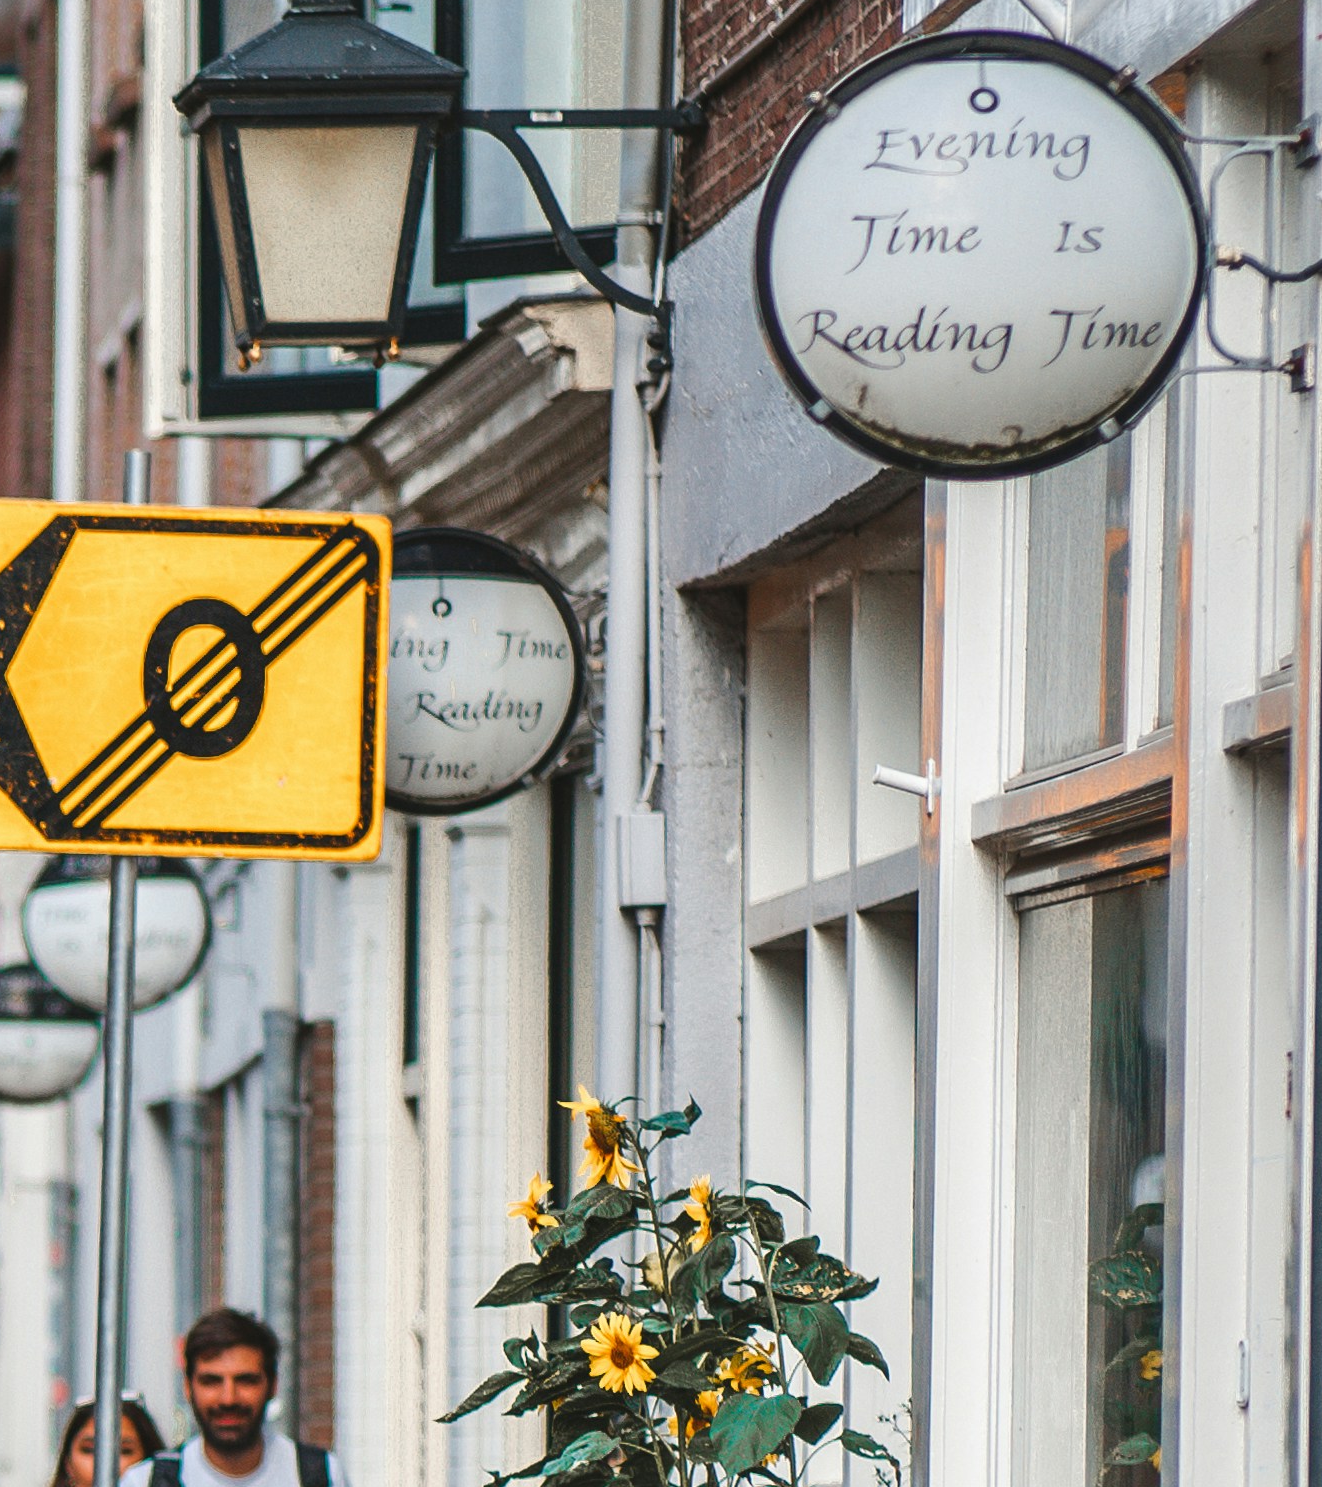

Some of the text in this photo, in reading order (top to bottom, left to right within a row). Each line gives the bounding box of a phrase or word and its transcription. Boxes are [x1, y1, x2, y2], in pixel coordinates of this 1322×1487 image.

[863, 116, 1092, 181] Evening
[844, 209, 1105, 276] Time Is
[796, 305, 1163, 374] Reading Time
[492, 629, 569, 672] Time
[405, 689, 543, 733] Reading
[397, 752, 477, 782] Time
